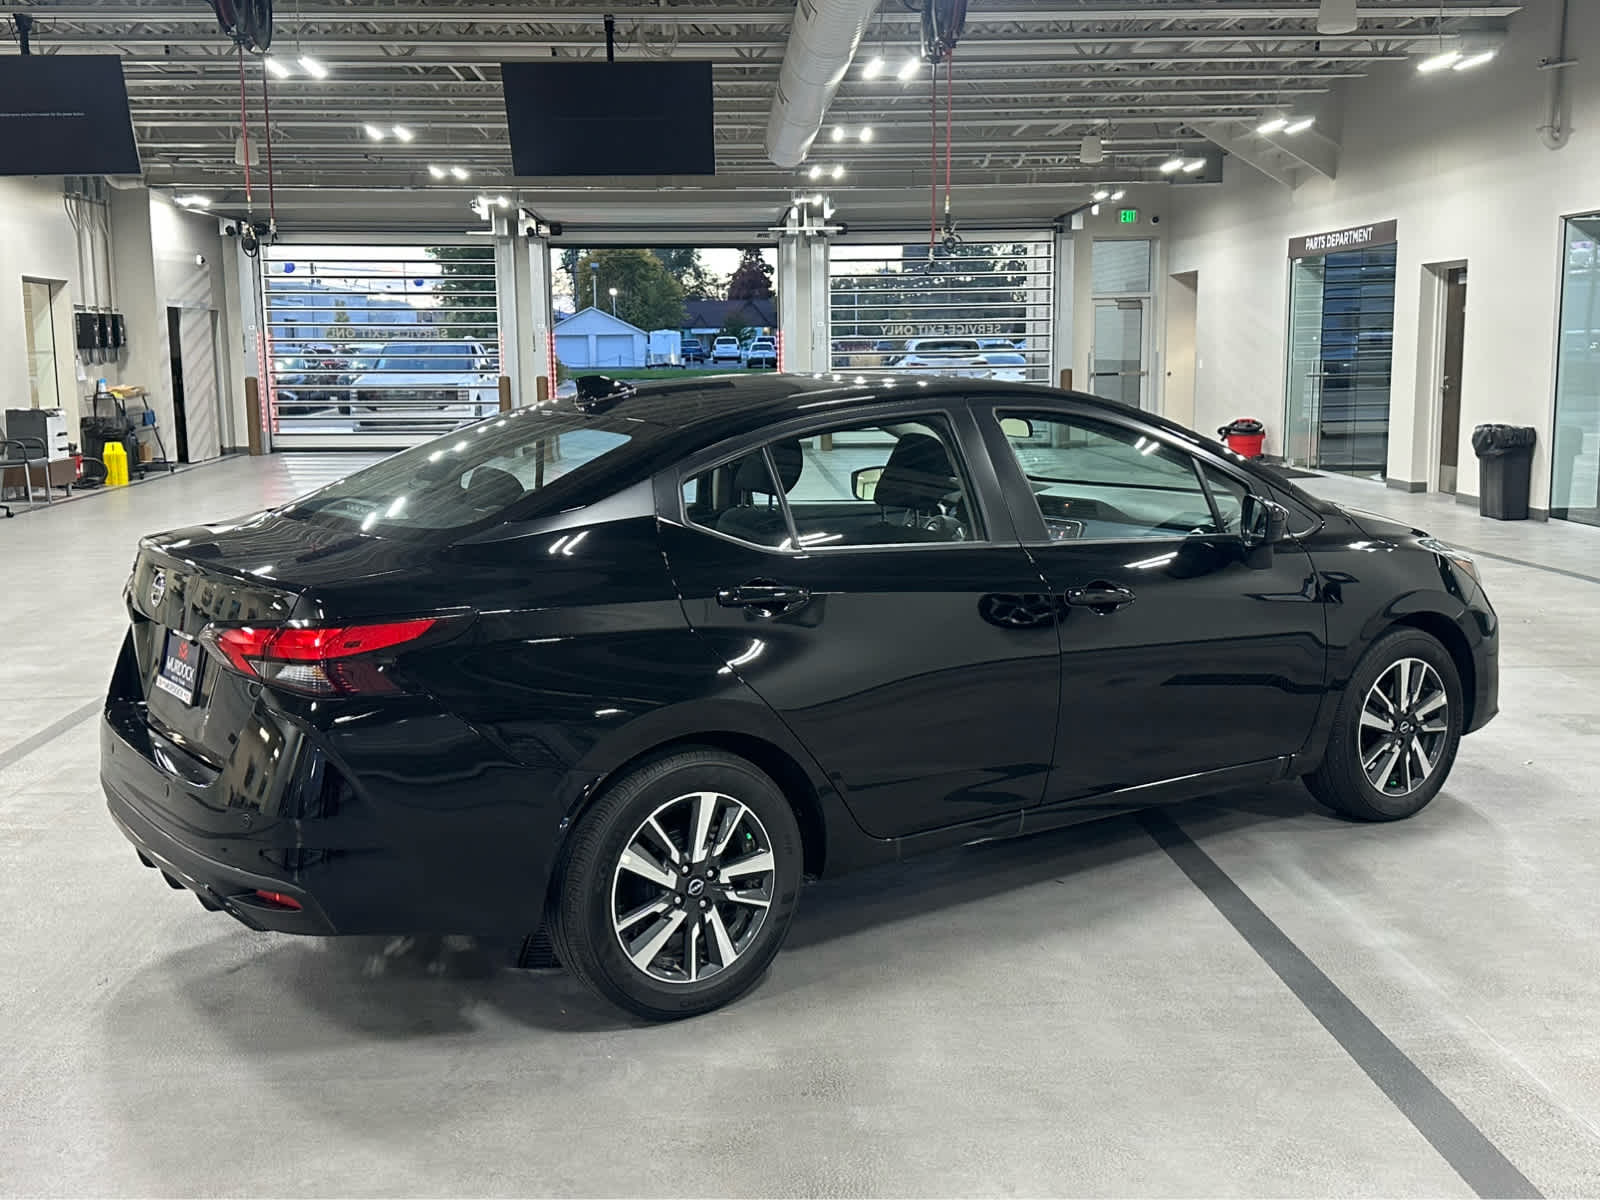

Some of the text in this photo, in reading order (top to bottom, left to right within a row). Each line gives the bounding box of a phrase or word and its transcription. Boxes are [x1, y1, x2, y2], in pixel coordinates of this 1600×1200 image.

[1120, 209, 1137, 223] EXIT
[1305, 227, 1373, 250] PARTS DEPARTMENT
[166, 656, 195, 682] MURDOCK
